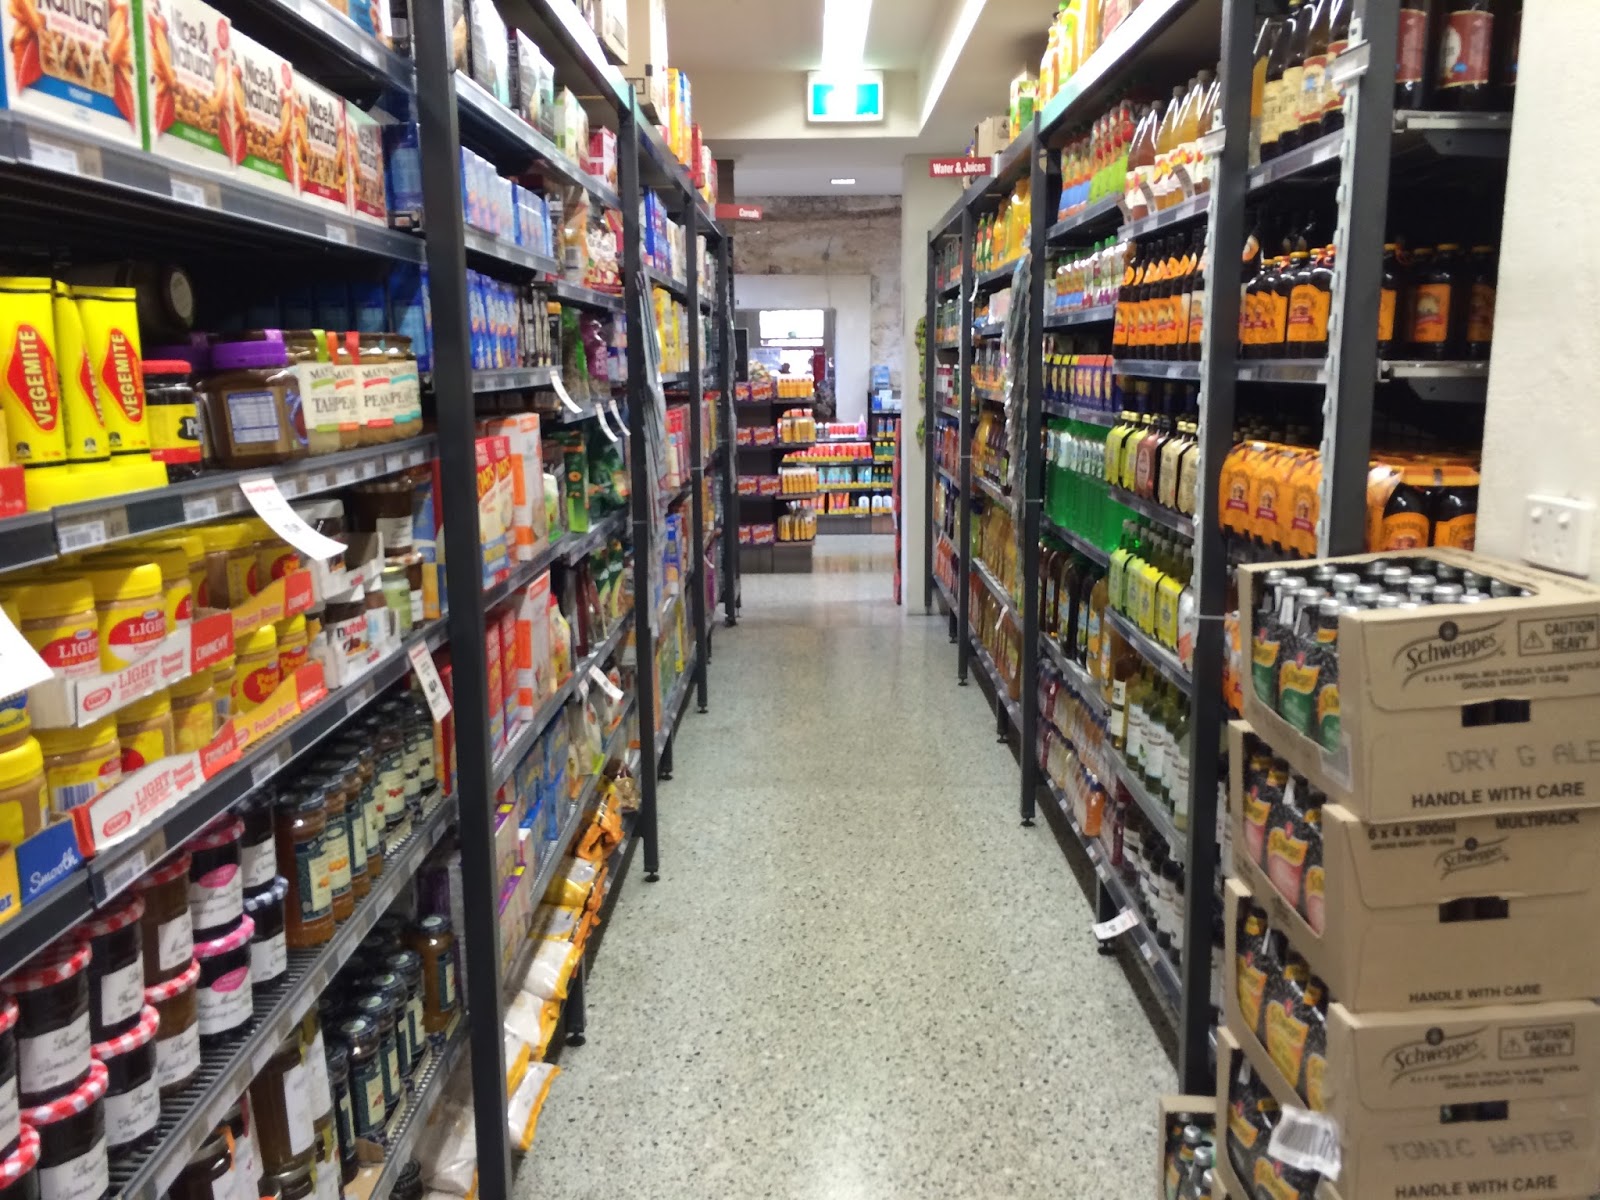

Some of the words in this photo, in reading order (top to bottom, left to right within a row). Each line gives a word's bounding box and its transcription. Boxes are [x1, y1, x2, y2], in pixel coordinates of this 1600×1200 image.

[245, 54, 267, 89] Nice
[267, 66, 276, 95] &
[244, 79, 281, 118] Natural
[309, 94, 328, 121] Nice
[307, 114, 337, 151] Natural
[932, 162, 954, 174] Water
[954, 161, 962, 173] &
[963, 161, 986, 173] Juices
[18, 329, 55, 426] VEGEMITE
[110, 333, 140, 418] VEGEMITE
[128, 617, 166, 637] LIGH
[1544, 619, 1595, 636] CAUTION
[58, 638, 99, 659] LIGH
[1406, 632, 1498, 672] Schweppes
[1551, 635, 1590, 650] HEAVY
[118, 657, 159, 689] LIGHT
[1446, 748, 1499, 773] DRY
[1516, 743, 1536, 768] G
[135, 767, 171, 806] LIGHT
[1411, 788, 1483, 809] HANDLE
[1487, 785, 1531, 803] WITH
[1535, 781, 1585, 798] CARE
[1368, 826, 1377, 840] 6
[1392, 825, 1400, 838] 4
[1495, 812, 1580, 830] MULTIPACK
[29, 846, 79, 894] Smooth
[1409, 989, 1463, 1003] HANDLE
[1466, 986, 1500, 998] WITH
[1503, 983, 1541, 997] CARE
[1523, 1028, 1571, 1042] CAUTION
[1394, 1038, 1479, 1070] Schweppes
[1385, 1137, 1476, 1162] TONIC
[1488, 1129, 1578, 1155] WATER
[1394, 1180, 1463, 1200] HANDLE
[1467, 1178, 1508, 1194] WITH
[1512, 1174, 1558, 1192] CARE
